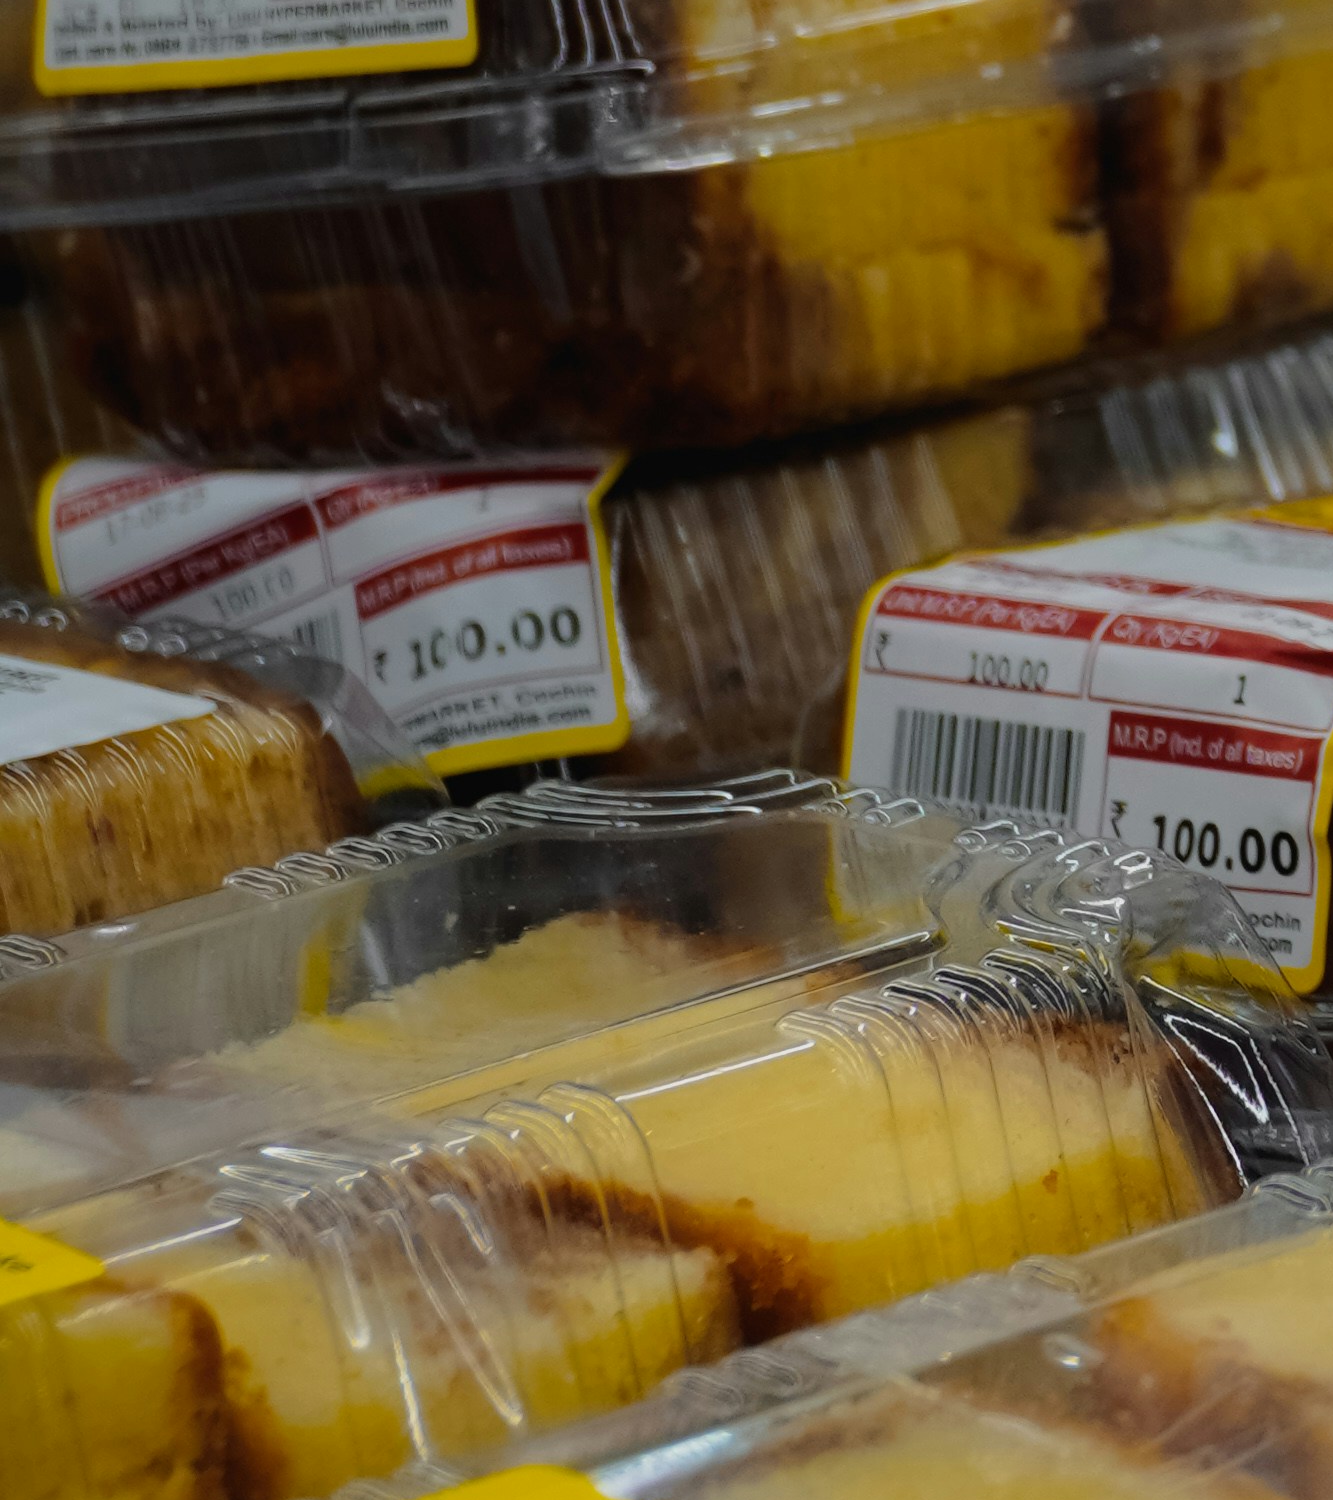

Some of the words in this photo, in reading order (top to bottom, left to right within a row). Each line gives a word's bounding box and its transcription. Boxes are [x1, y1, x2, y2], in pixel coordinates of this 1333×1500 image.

[409, 605, 582, 682] 100.00
[968, 650, 1049, 693] 100.00
[1233, 673, 1247, 706] 1
[1113, 722, 1167, 751] M.R.P
[1207, 737, 1224, 760] of
[1225, 739, 1244, 763] all
[1246, 743, 1304, 776] taxes)
[1153, 814, 1300, 877] 100.00
[1248, 909, 1302, 933] ochin
